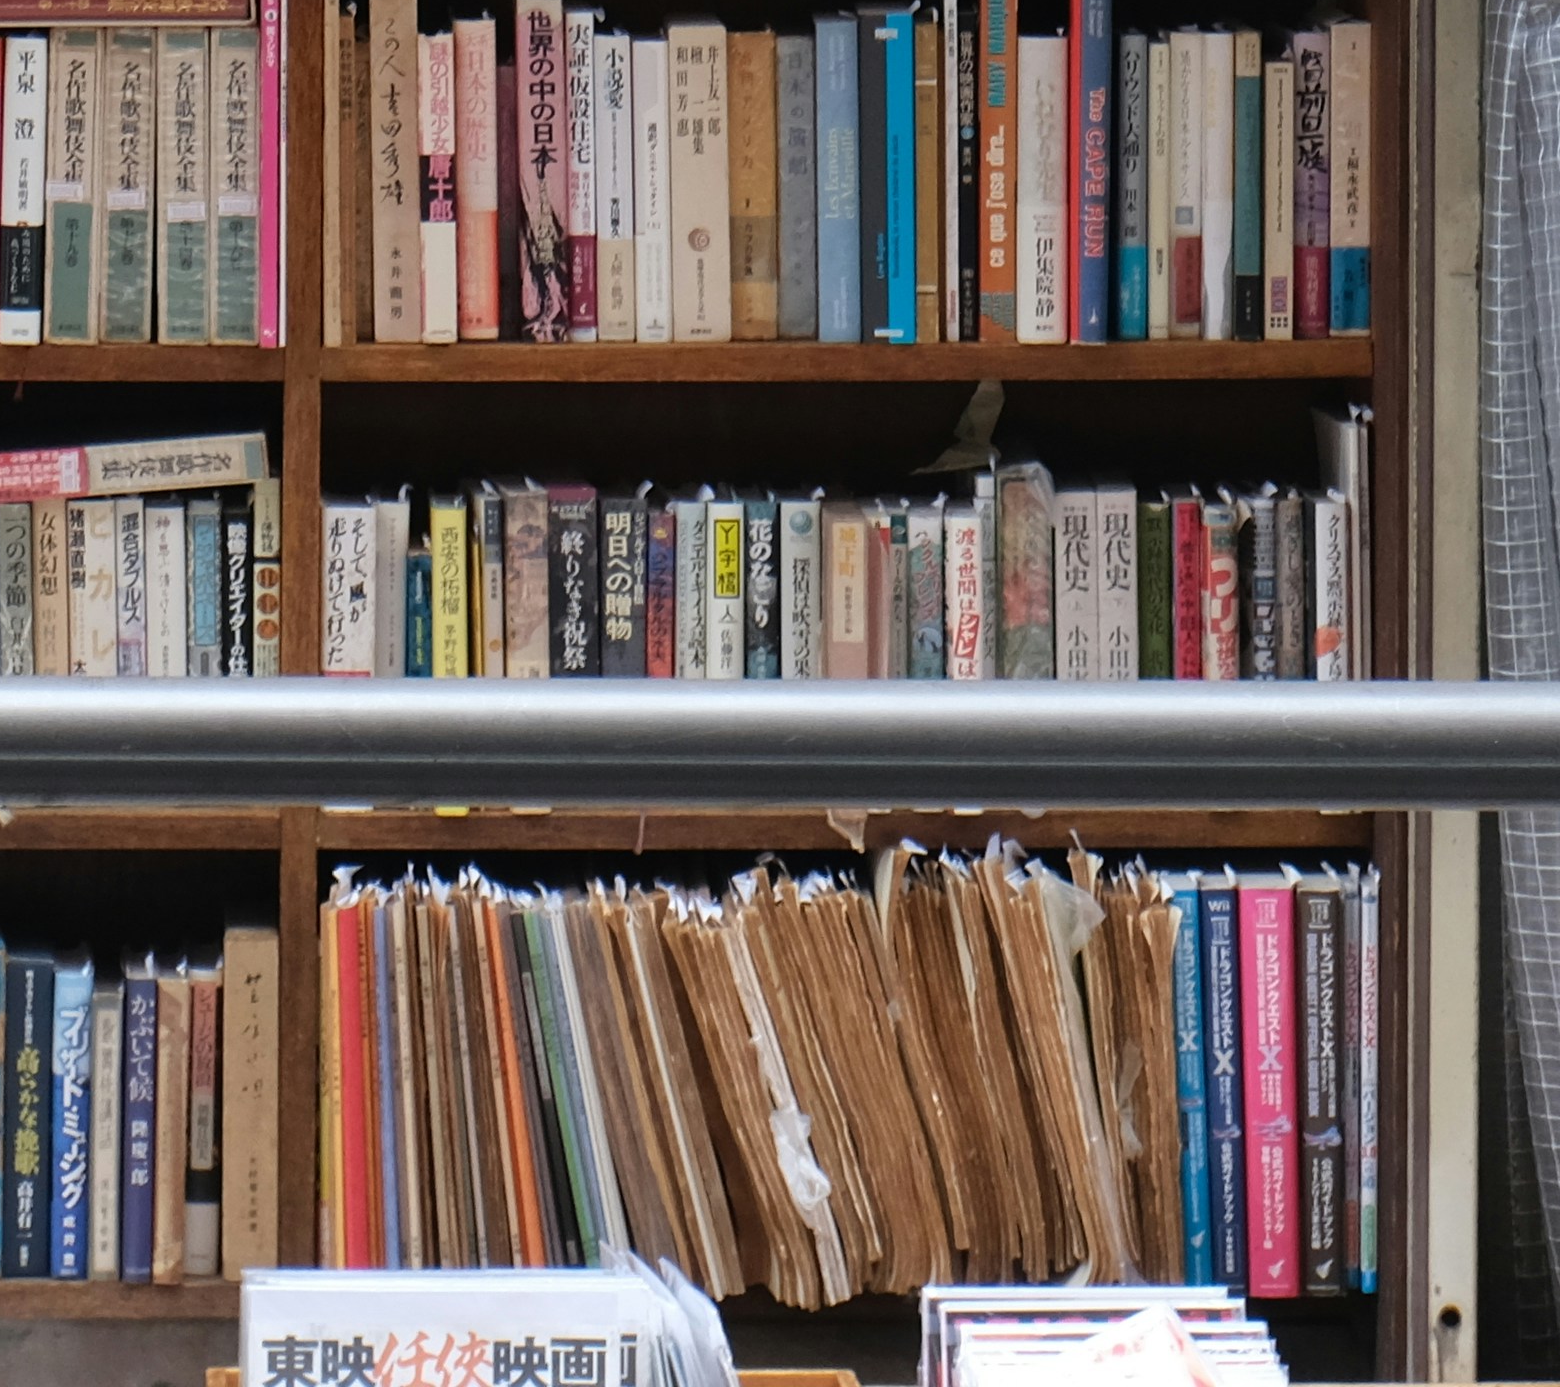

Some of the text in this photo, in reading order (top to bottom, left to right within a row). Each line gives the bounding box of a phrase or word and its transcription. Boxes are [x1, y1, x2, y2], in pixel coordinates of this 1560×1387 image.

[429, 42, 450, 155] 謎の引越少女
[527, 10, 558, 178] 世界の中の日本
[1122, 49, 1141, 174] ハリウッド大通り
[429, 156, 453, 220] 唐十郎
[1084, 87, 1106, 258] The CAPE RUN
[1035, 236, 1055, 318] 伊集院静
[326, 517, 345, 666] 走りぬけて行った
[561, 531, 587, 671] 終りなき祝祭
[605, 513, 633, 642] 明日への贈物
[688, 520, 706, 667] ダニエル・キイス読本
[955, 529, 978, 610] 渡る世間は
[1062, 515, 1091, 594] 現代史
[1103, 515, 1133, 594] 現代史
[1208, 899, 1231, 912] Wii
[129, 993, 155, 1104] かぶいて候
[15, 1048, 41, 1177] 高らかな挽歌
[130, 1119, 150, 1187] 隆慶一郎
